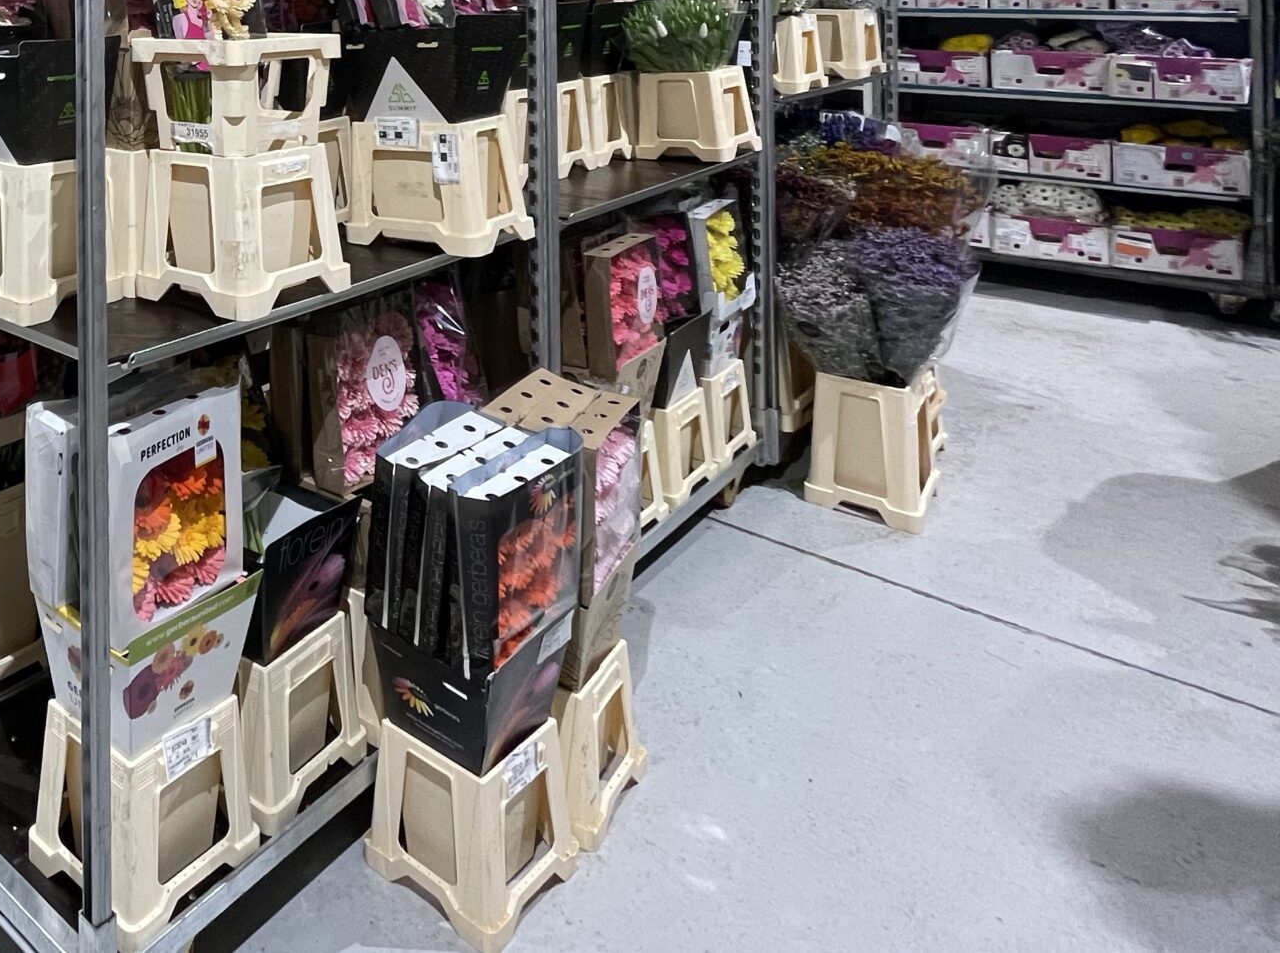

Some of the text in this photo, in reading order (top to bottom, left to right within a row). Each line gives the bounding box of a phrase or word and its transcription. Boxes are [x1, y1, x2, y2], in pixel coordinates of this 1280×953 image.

[186, 127, 209, 139] 31955
[140, 426, 191, 462] PERFECTION
[279, 517, 344, 573] florein
[468, 518, 492, 606] gerberas
